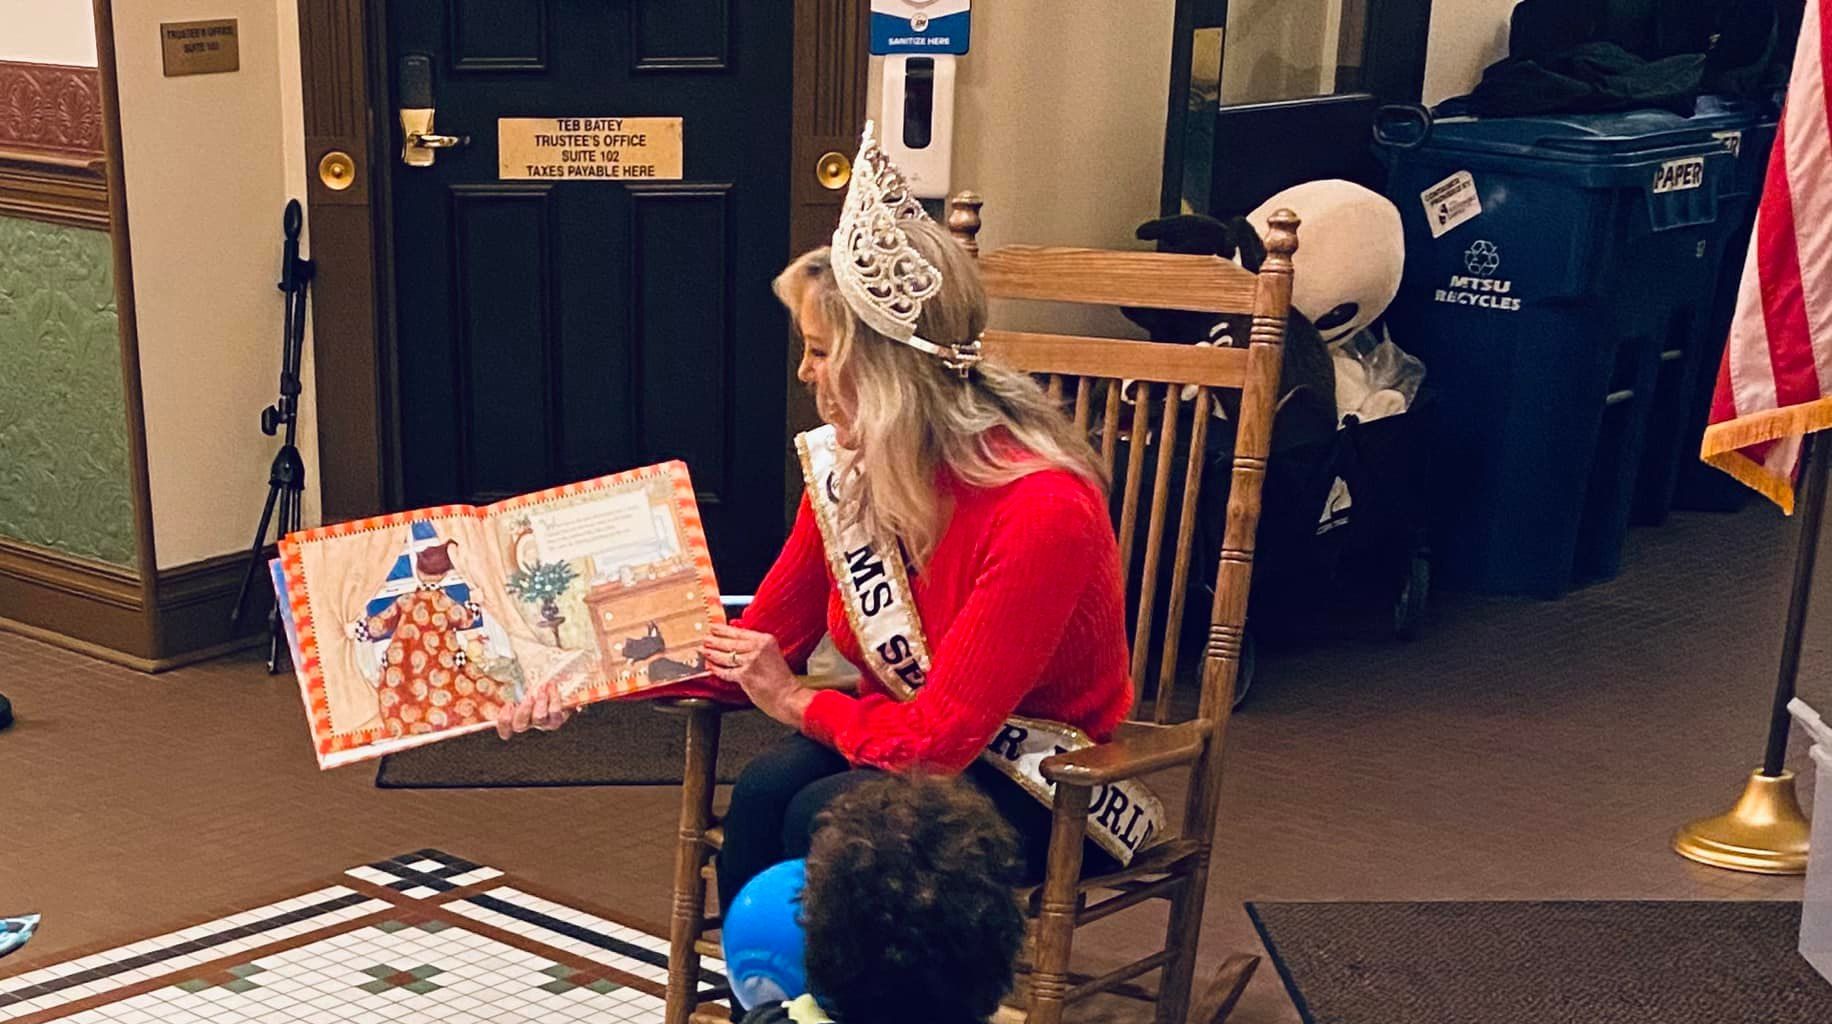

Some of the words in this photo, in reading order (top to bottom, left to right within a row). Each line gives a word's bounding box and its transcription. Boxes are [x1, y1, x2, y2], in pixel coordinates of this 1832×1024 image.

[888, 37, 926, 45] SANITIZE
[927, 37, 950, 45] HERE
[556, 119, 581, 132] TEB
[585, 119, 624, 132] BATEY
[535, 134, 600, 147] TRUSTEE'S
[603, 134, 647, 147] OFFICE
[562, 150, 596, 163] SUITE
[600, 150, 620, 162] 102
[526, 165, 564, 177] TAXES
[568, 165, 619, 177] PAYABLE
[623, 165, 656, 177] HERE
[1654, 161, 1703, 190] PAPER
[1450, 275, 1511, 293] MTSU
[1434, 289, 1522, 311] RECYCLES
[843, 544, 894, 618] MS
